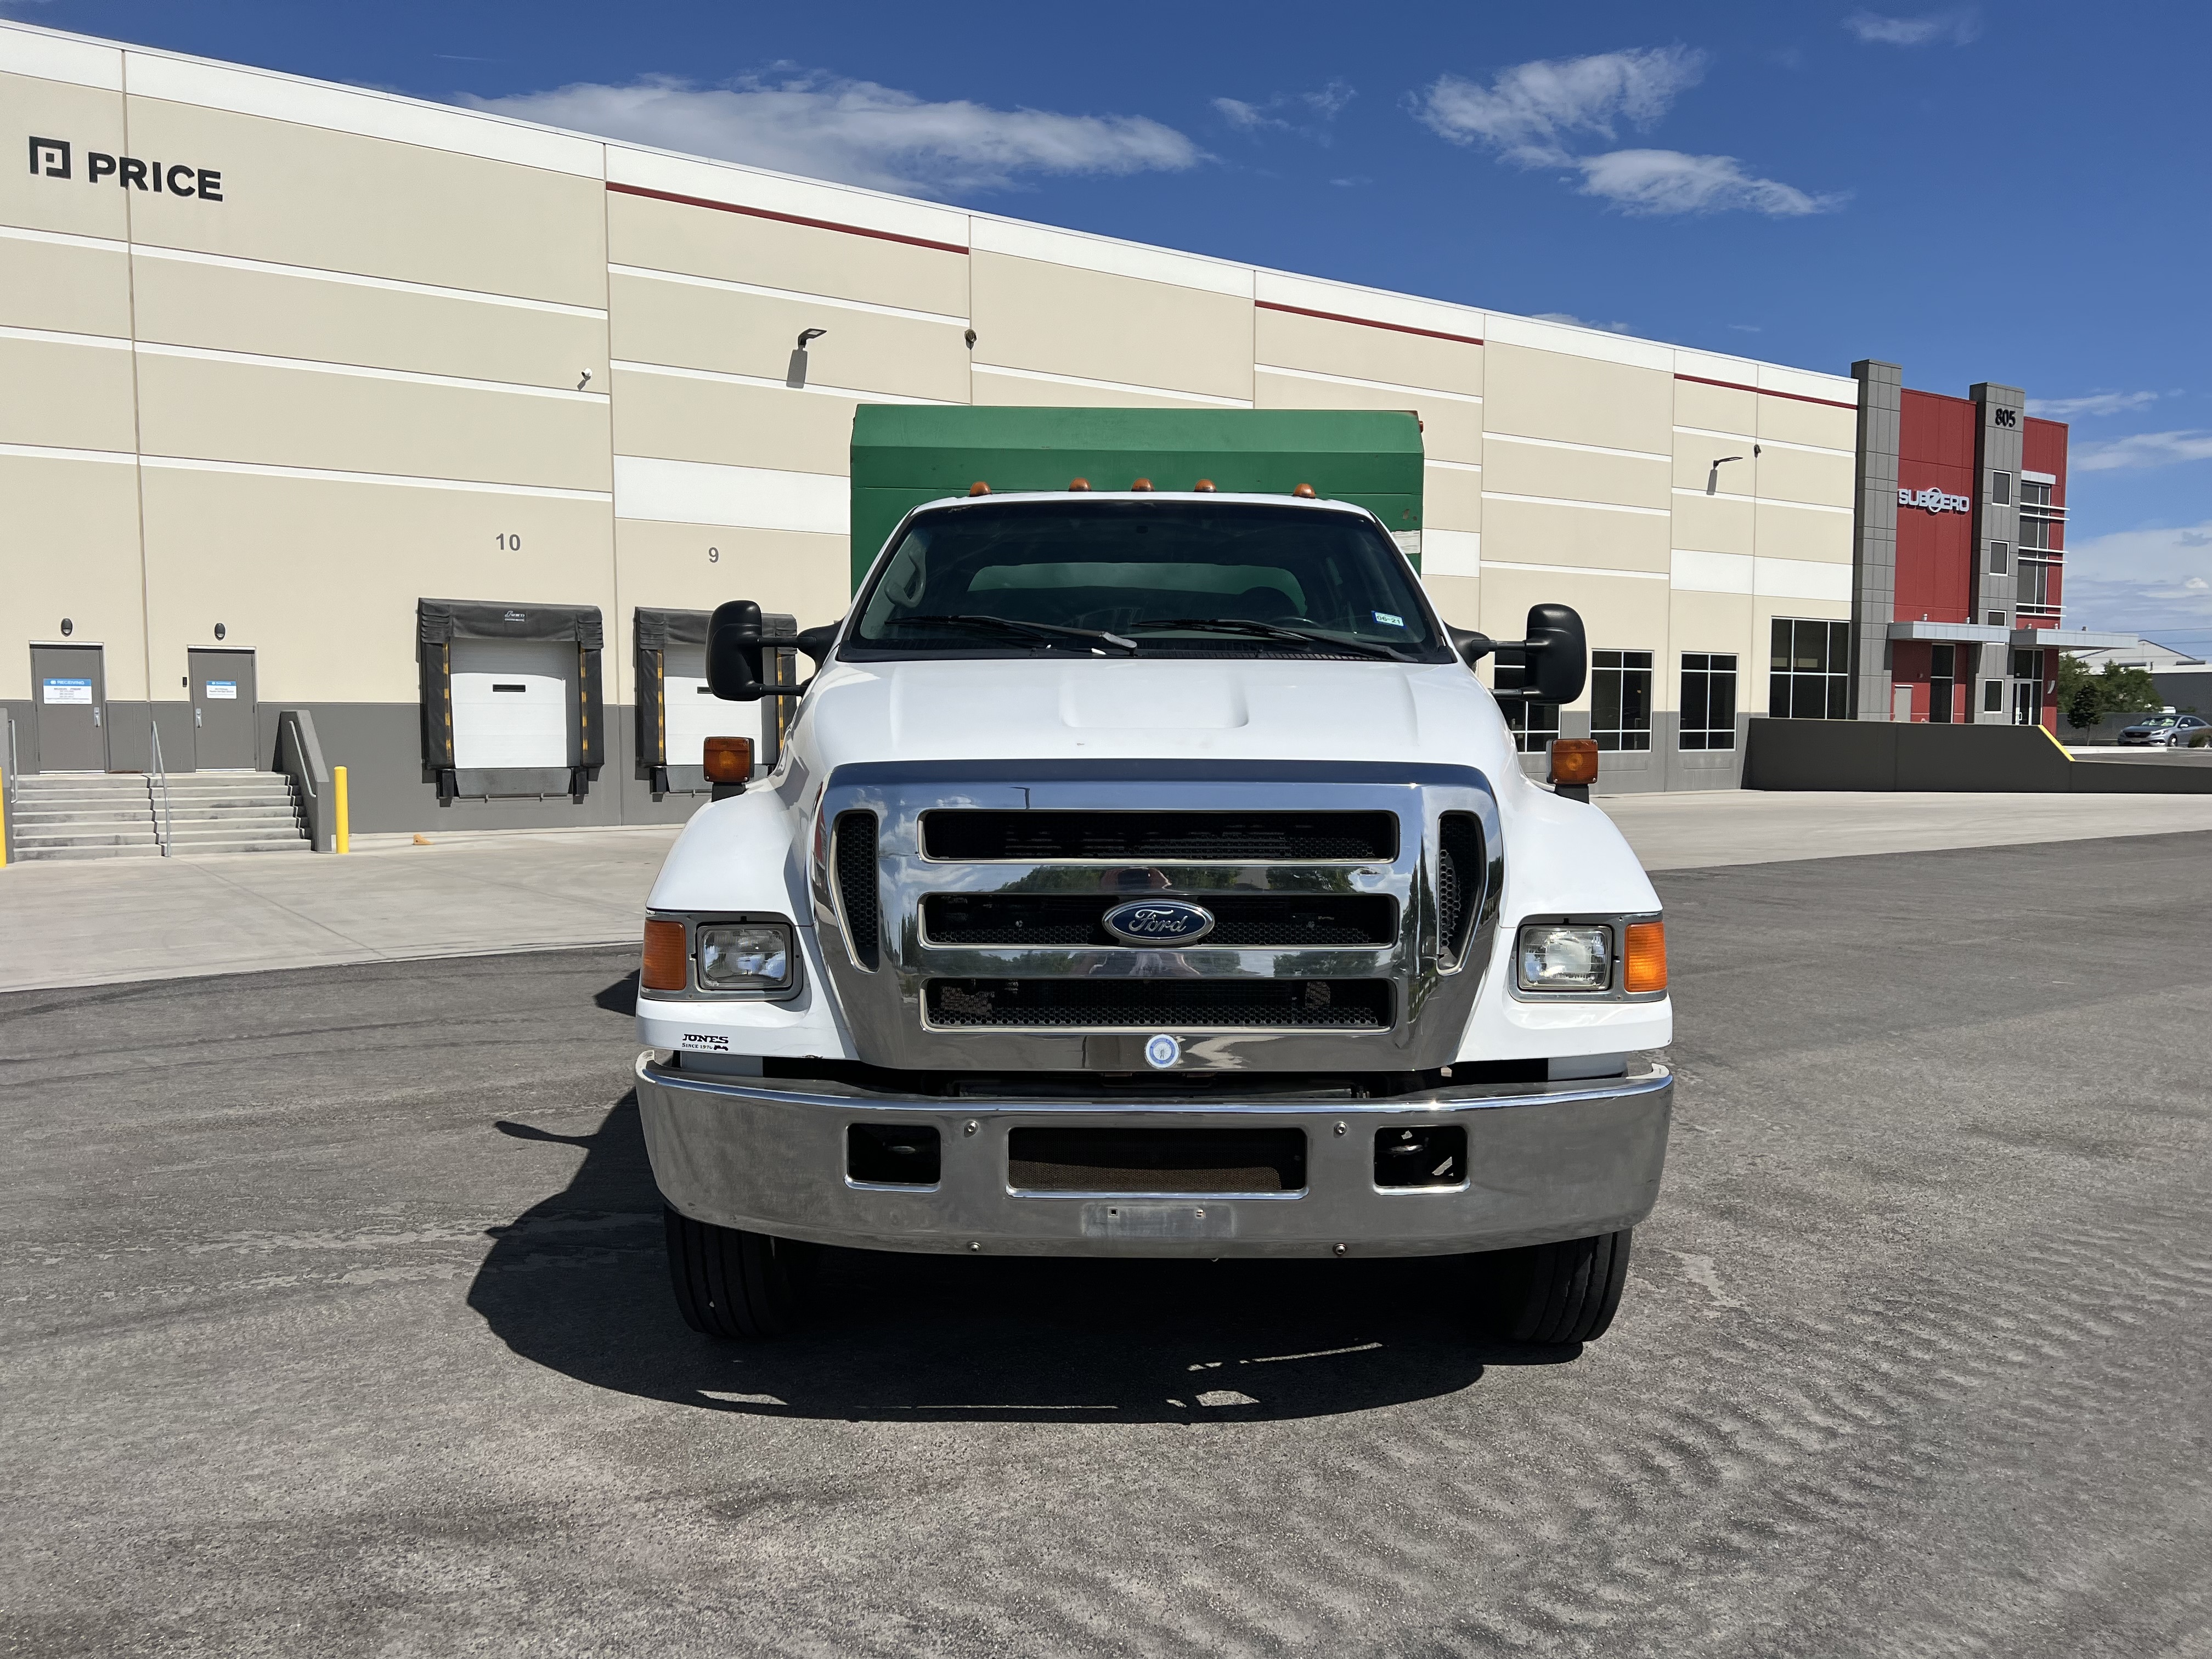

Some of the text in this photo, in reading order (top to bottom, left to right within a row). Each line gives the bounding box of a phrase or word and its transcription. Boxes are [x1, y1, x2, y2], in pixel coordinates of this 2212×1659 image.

[88, 151, 223, 202] PRICE
[1995, 408, 2016, 428] 805
[1898, 487, 1970, 513] SUBZERO
[496, 533, 521, 551] 10
[708, 546, 719, 563] 9
[1376, 615, 1401, 624] 06-21
[1128, 909, 1188, 932] Ford
[682, 1034, 729, 1044] JONES
